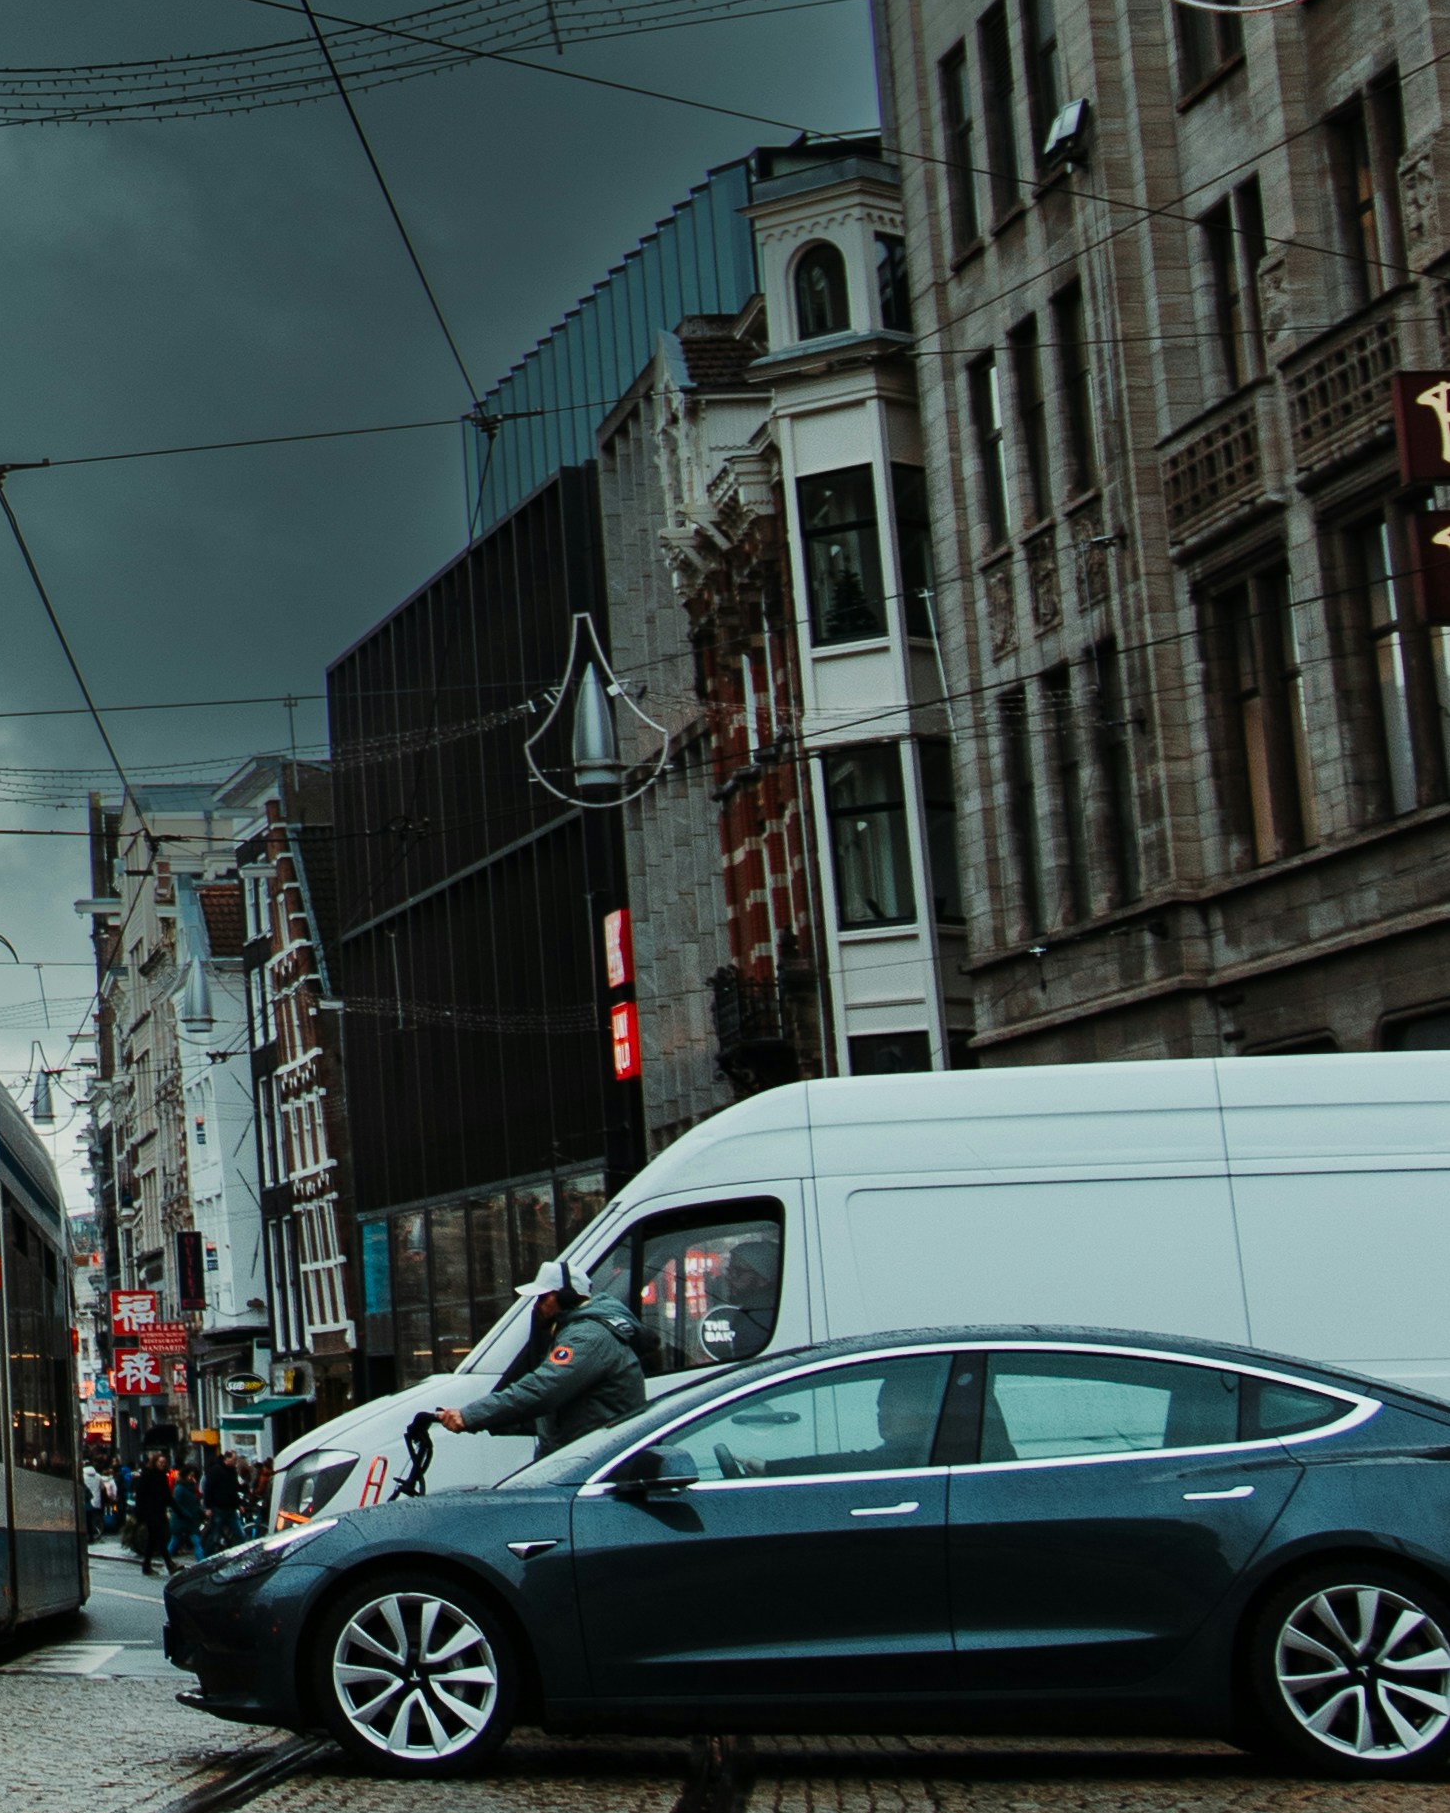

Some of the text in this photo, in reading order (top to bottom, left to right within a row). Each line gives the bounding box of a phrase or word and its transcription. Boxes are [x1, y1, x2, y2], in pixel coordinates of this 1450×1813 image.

[113, 1295, 156, 1332] 福
[704, 1320, 730, 1331] THE
[141, 1344, 186, 1352] MANDARIJN
